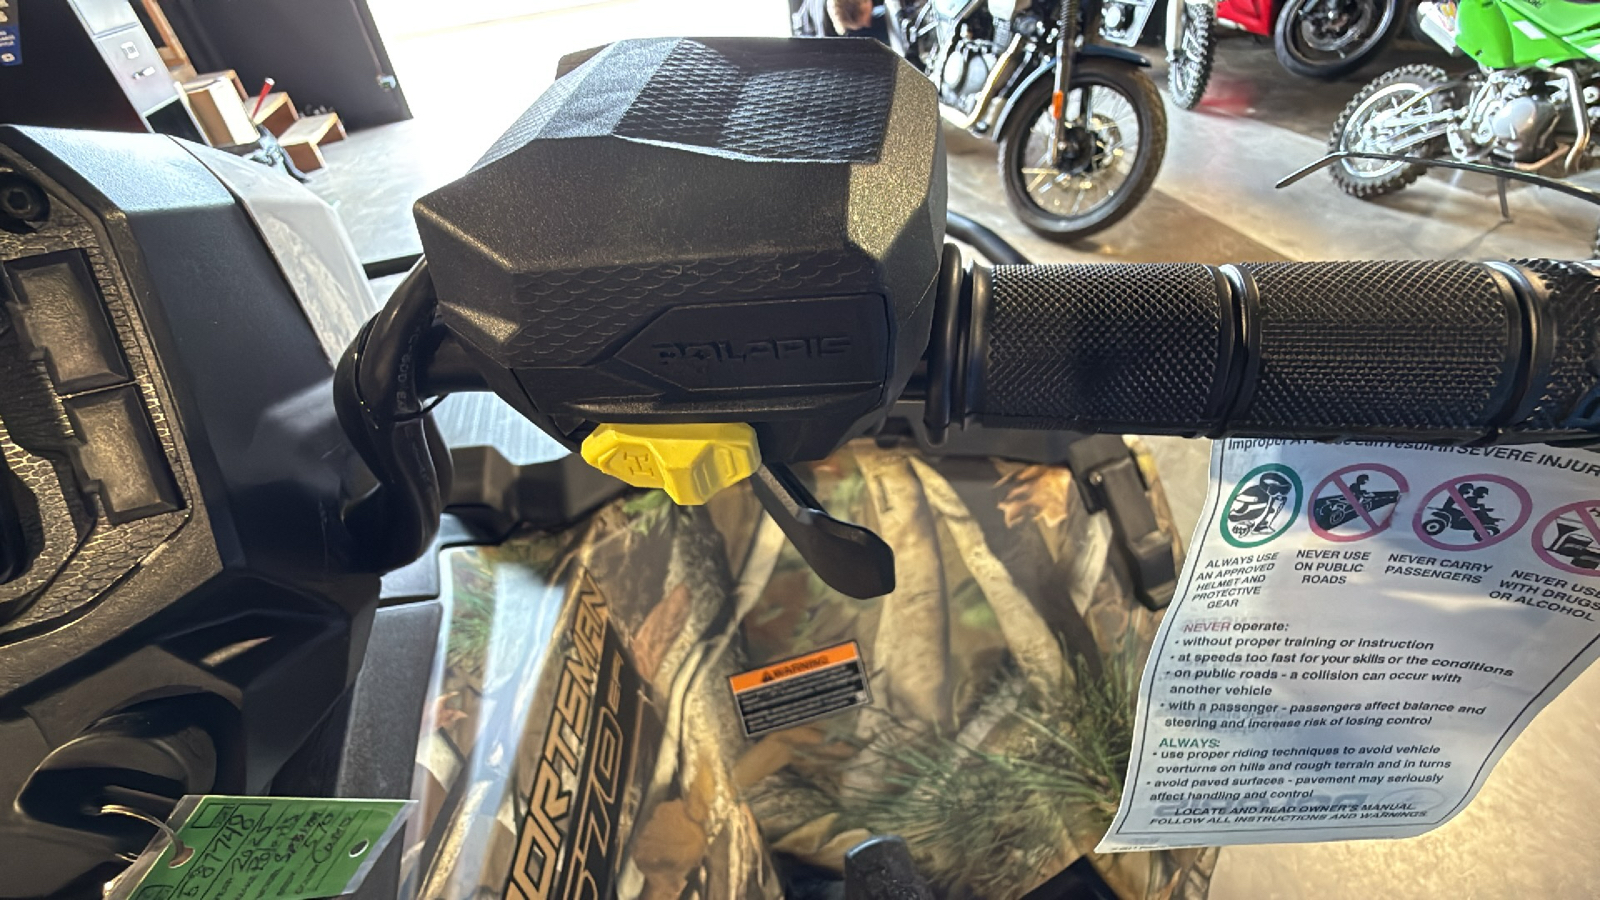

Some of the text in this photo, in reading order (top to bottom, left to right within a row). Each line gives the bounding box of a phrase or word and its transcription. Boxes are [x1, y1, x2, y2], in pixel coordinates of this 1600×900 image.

[651, 336, 851, 364] POLARIS
[1456, 446, 1537, 463] SEVERE
[1205, 552, 1280, 569] ALWAYS USE
[1296, 550, 1372, 561] NEVER USE
[1388, 553, 1494, 573] NEVER CARRY
[1195, 562, 1276, 581] AN APPROVED
[1294, 562, 1364, 573] ON PUBLIC
[1384, 565, 1483, 584] PASSENGERS
[1196, 574, 1266, 592] HELMET AND
[1301, 575, 1347, 584] ROADS
[1511, 569, 1568, 589] NEVER
[1191, 586, 1262, 601] PROTECTIVE
[1499, 580, 1600, 611] WITH DRUGS
[1207, 599, 1239, 609] GEAR
[1488, 590, 1596, 622] OR ALCOHOL
[1183, 621, 1289, 635] NEVER operate:
[1182, 636, 1434, 650] without proper training or instruction
[773, 655, 829, 677] WARNING
[1178, 652, 1515, 677] at speeds too fast for your skills or the conditions
[1174, 669, 1191, 678] on
[1194, 668, 1236, 680] public
[1239, 668, 1278, 679] roads
[1289, 671, 1298, 680] a
[1302, 669, 1358, 681] collision
[1362, 671, 1386, 681] can
[1389, 672, 1429, 681] occur
[1431, 673, 1462, 684] with
[1169, 684, 1272, 696] another vehicle
[1168, 700, 1196, 711] with
[1199, 702, 1207, 711] a
[1210, 702, 1279, 715] passenger
[1289, 702, 1361, 714] passengers
[1364, 700, 1401, 711] affect
[1402, 701, 1454, 712] balance
[1458, 705, 1487, 715] and
[1165, 716, 1433, 729] steering and increase risk of losing control
[504, 566, 610, 900] ORTSMAN
[1161, 744, 1441, 760] use proper riding techniques to avoid vehicle
[1156, 759, 1452, 774] overturns on hills and rough terrain and in turns
[1154, 778, 1189, 787] avoid
[1191, 777, 1233, 788] paved
[1232, 776, 1285, 786] surfaces
[1295, 774, 1356, 785] pavement
[1358, 775, 1385, 785] may
[1387, 773, 1444, 784] seriously
[1150, 789, 1314, 801] affect handling and control
[1174, 807, 1225, 816] LOCATE
[1229, 806, 1258, 815] AND
[1260, 805, 1296, 814] READ
[1298, 804, 1359, 814] OWNER'S
[1149, 817, 1206, 826] FOLLOW
[1206, 816, 1231, 824] ALL
[1234, 814, 1327, 824] INSTRUCTIONS
[1329, 812, 1357, 820] AND
